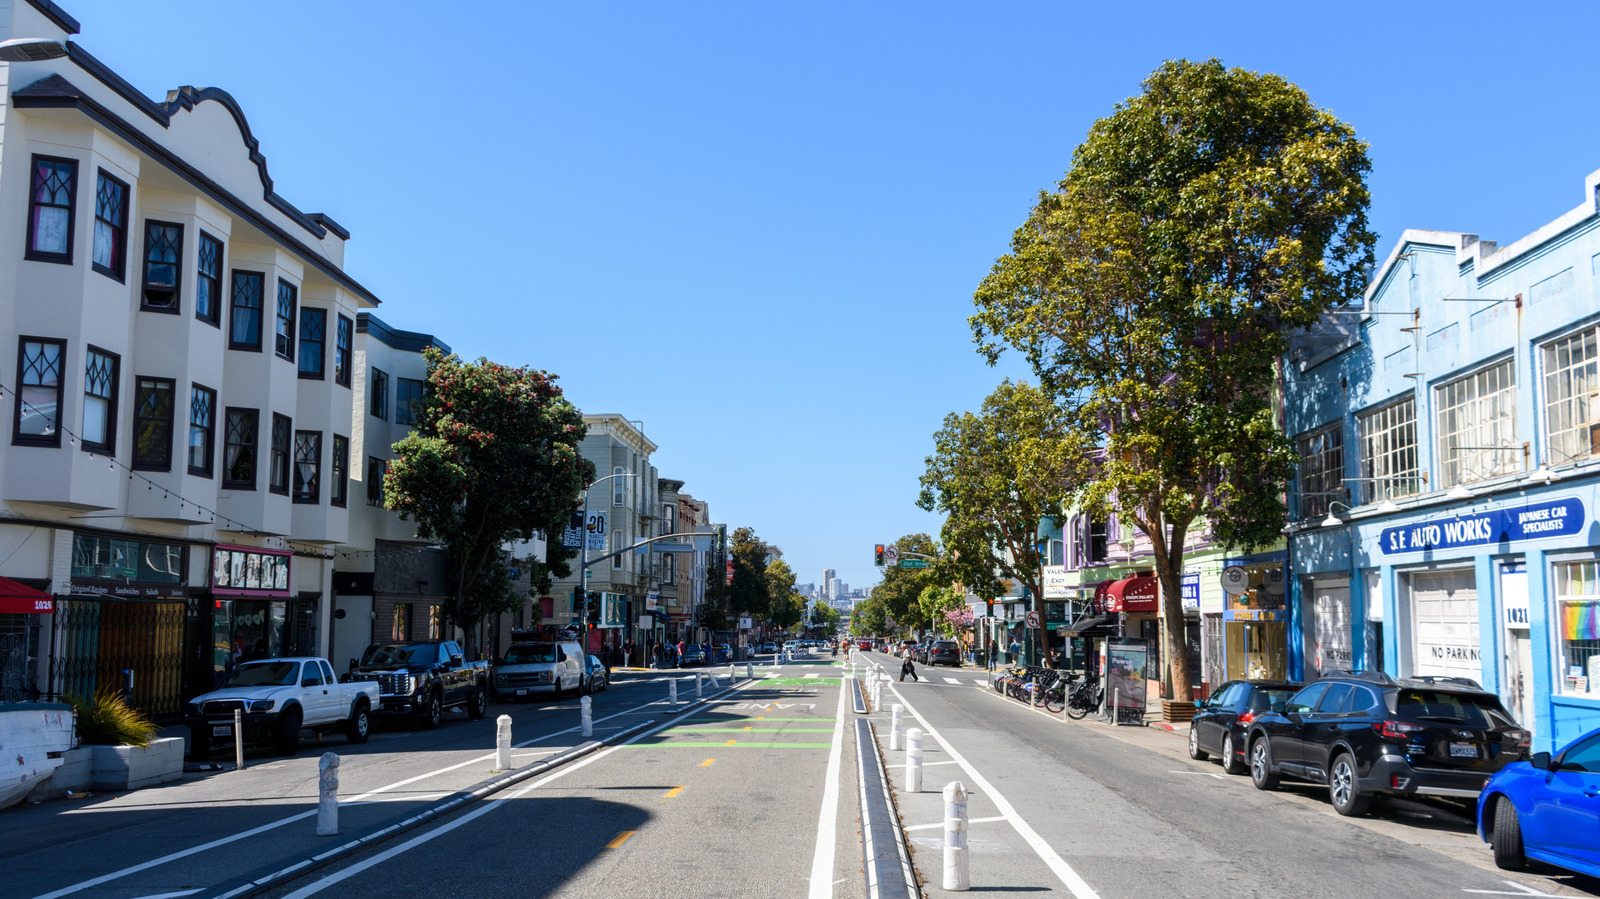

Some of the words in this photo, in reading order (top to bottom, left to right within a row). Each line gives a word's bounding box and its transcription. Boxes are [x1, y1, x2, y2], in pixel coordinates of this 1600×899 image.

[1518, 509, 1551, 525] JAPANESE
[1551, 506, 1568, 518] CAR
[590, 516, 604, 534] 20
[1522, 519, 1564, 534] SPECIALISTS
[1410, 524, 1441, 548] AUTO
[1444, 517, 1492, 543] WORKS
[71, 583, 90, 593] Original
[91, 585, 108, 595] Recipes
[115, 586, 140, 595] Sandwiches
[145, 588, 159, 596] Salads
[171, 588, 183, 597] Juices
[34, 600, 52, 610] 1026
[1506, 607, 1529, 624] 1021
[1326, 650, 1335, 660] NO
[1432, 646, 1443, 659] NO
